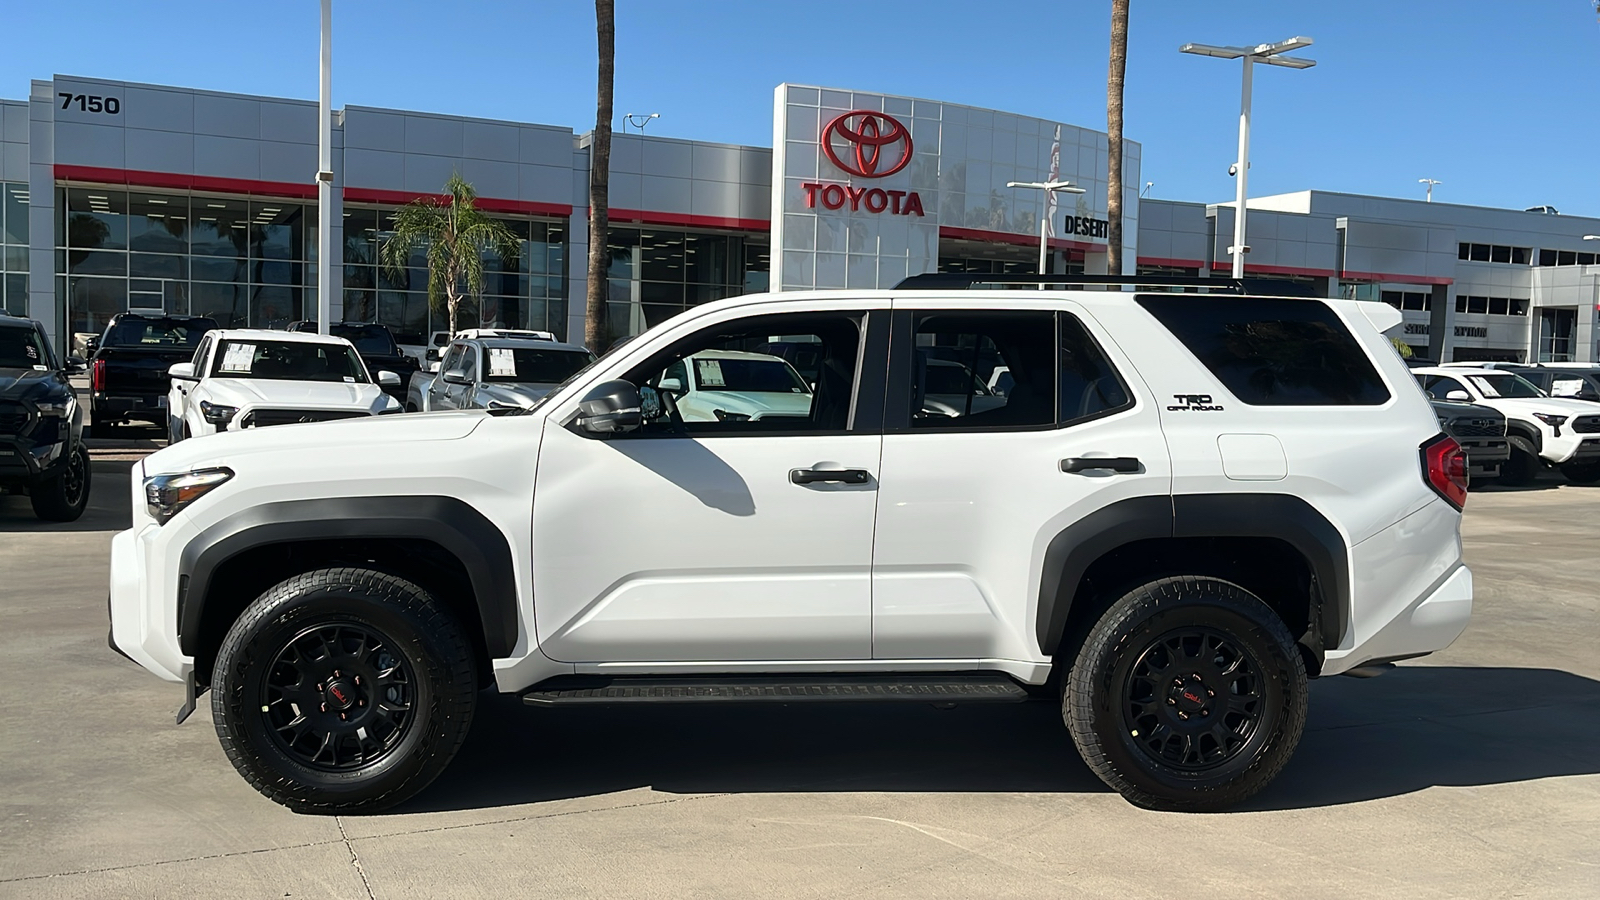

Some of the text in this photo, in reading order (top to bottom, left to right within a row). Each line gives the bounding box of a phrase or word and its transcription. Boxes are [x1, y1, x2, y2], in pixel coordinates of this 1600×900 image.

[58, 92, 120, 115] 7150
[801, 183, 925, 217] TOYOTA
[1065, 215, 1109, 239] DESERT
[1173, 394, 1213, 406] TRD
